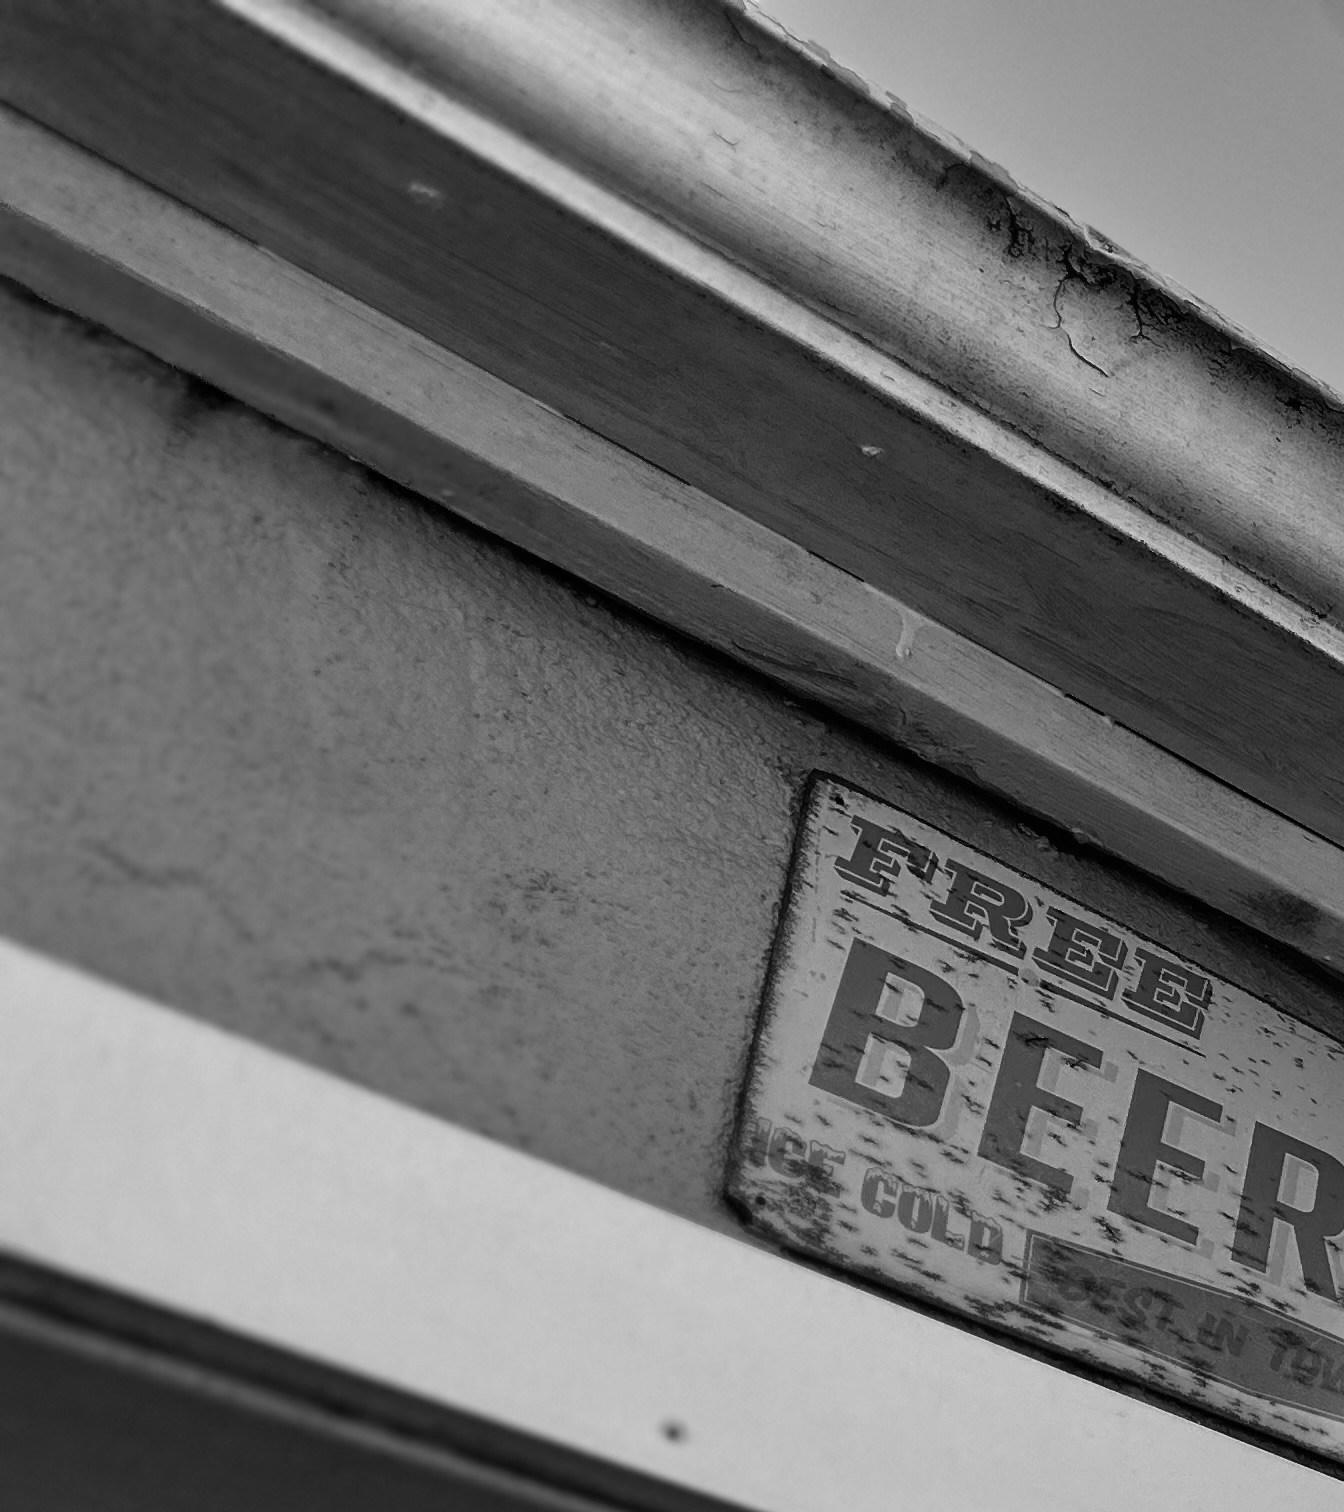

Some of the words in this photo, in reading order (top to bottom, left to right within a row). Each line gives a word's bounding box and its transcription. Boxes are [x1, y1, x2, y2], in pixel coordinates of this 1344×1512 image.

[833, 814, 1213, 1040] FREE
[748, 1116, 846, 1199] ICE
[861, 1166, 1004, 1266] COLD
[1055, 1262, 1183, 1330] BEST
[1196, 1311, 1248, 1357] IN
